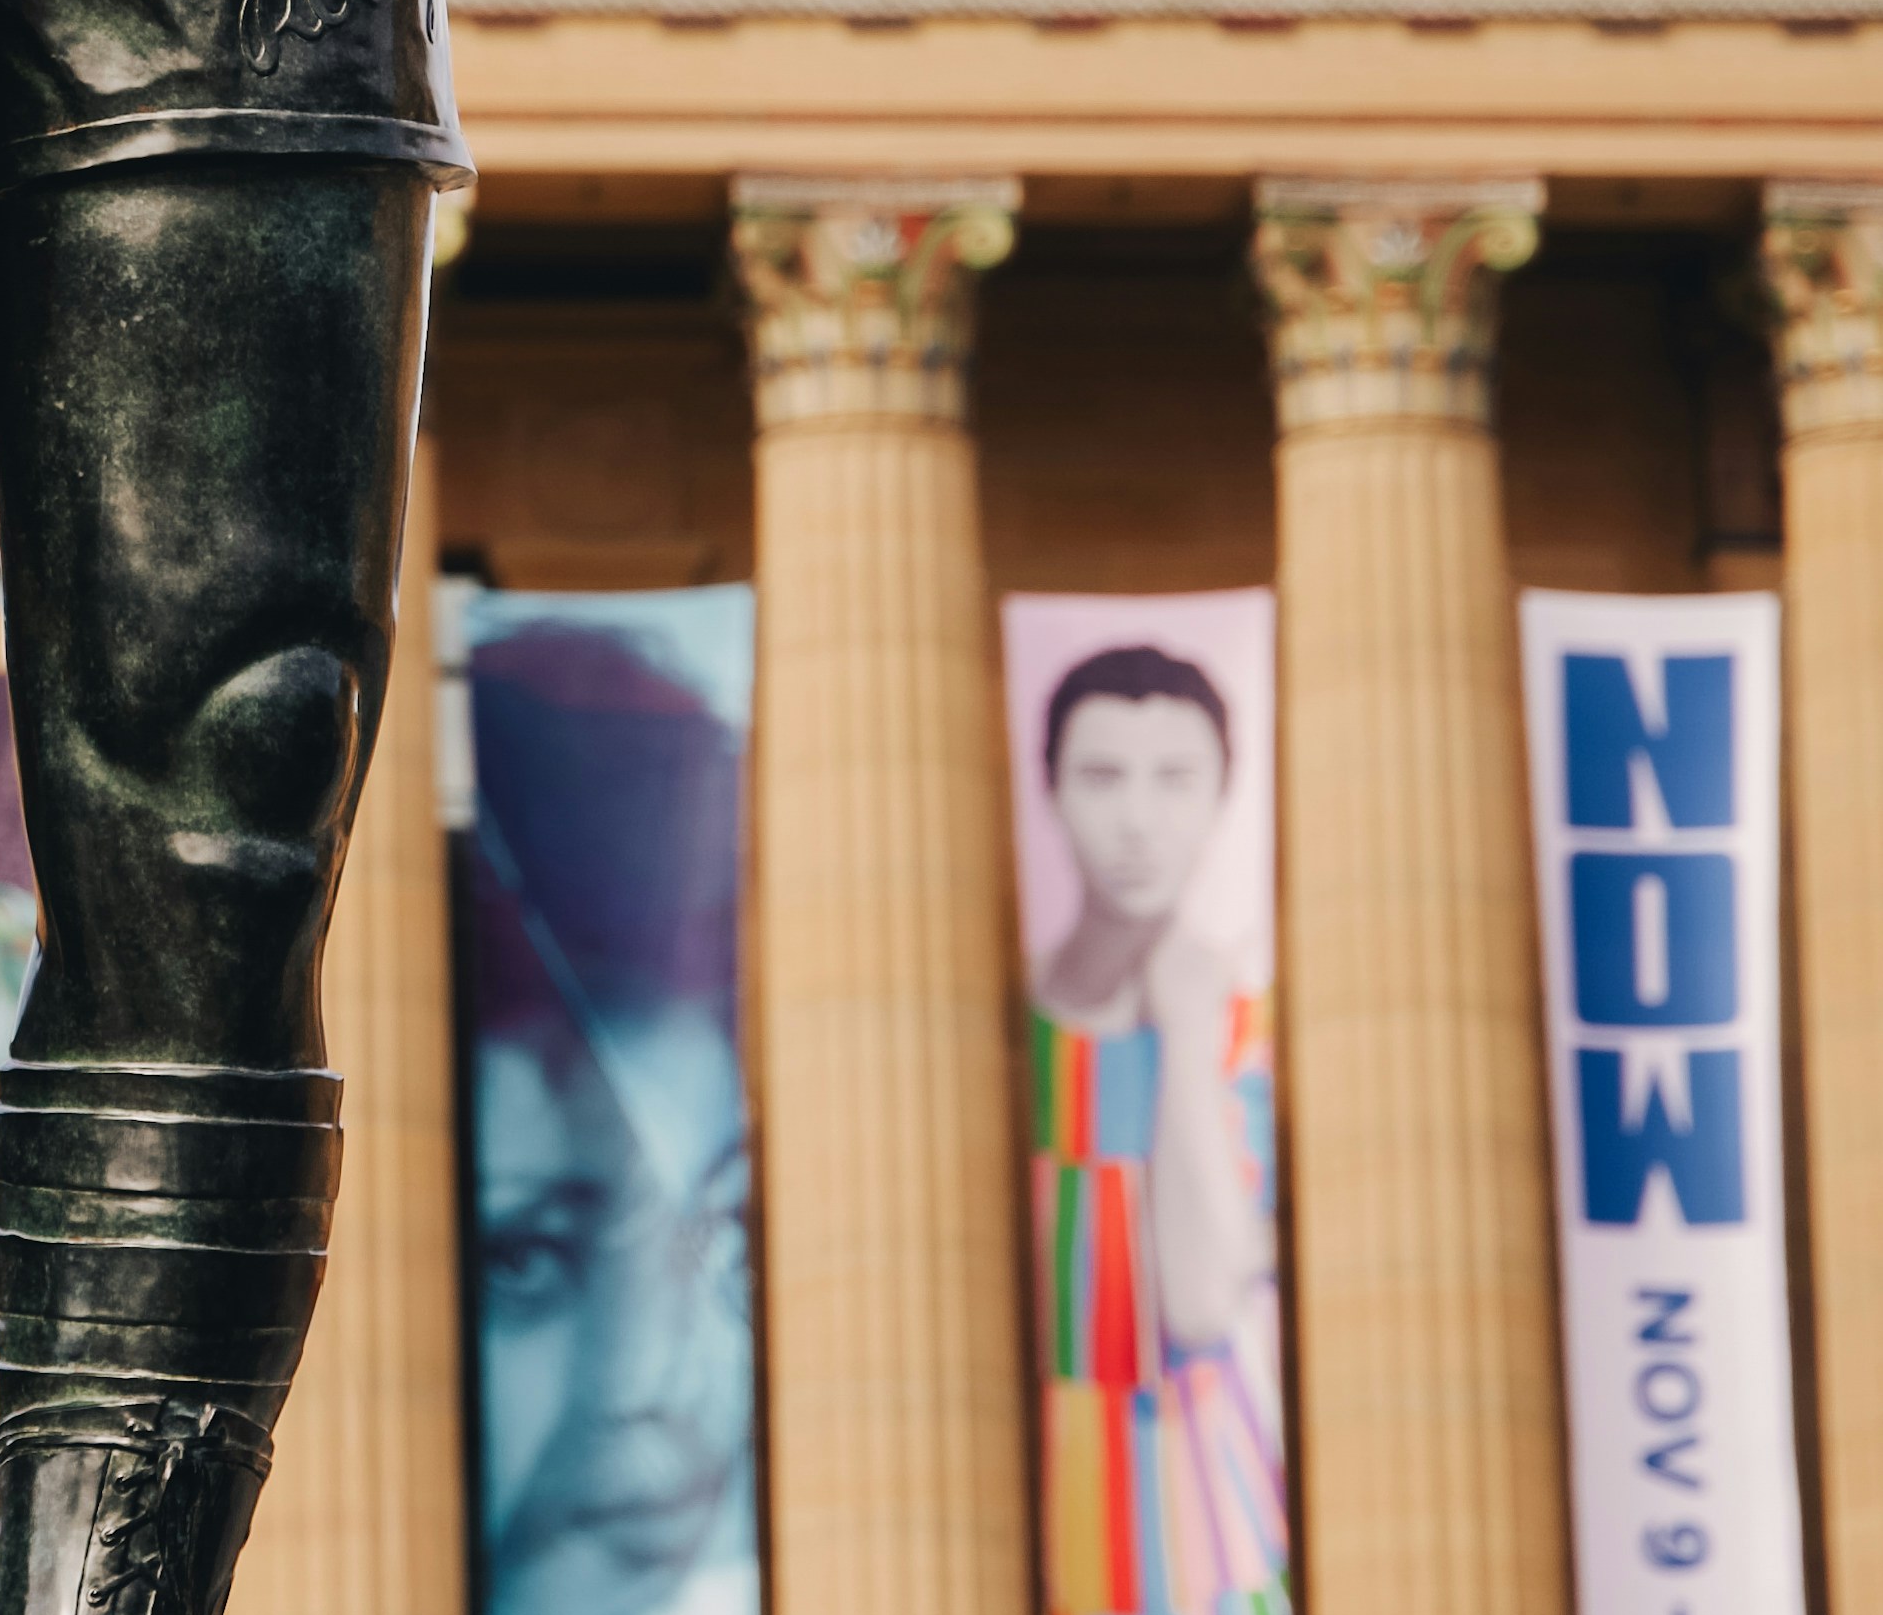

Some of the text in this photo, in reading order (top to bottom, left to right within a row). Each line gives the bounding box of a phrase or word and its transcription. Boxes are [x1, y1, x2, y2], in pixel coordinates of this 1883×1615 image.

[1560, 651, 1746, 1228] NOW
[1633, 1286, 1704, 1491] NOV
[1643, 1521, 1710, 1573] 9
